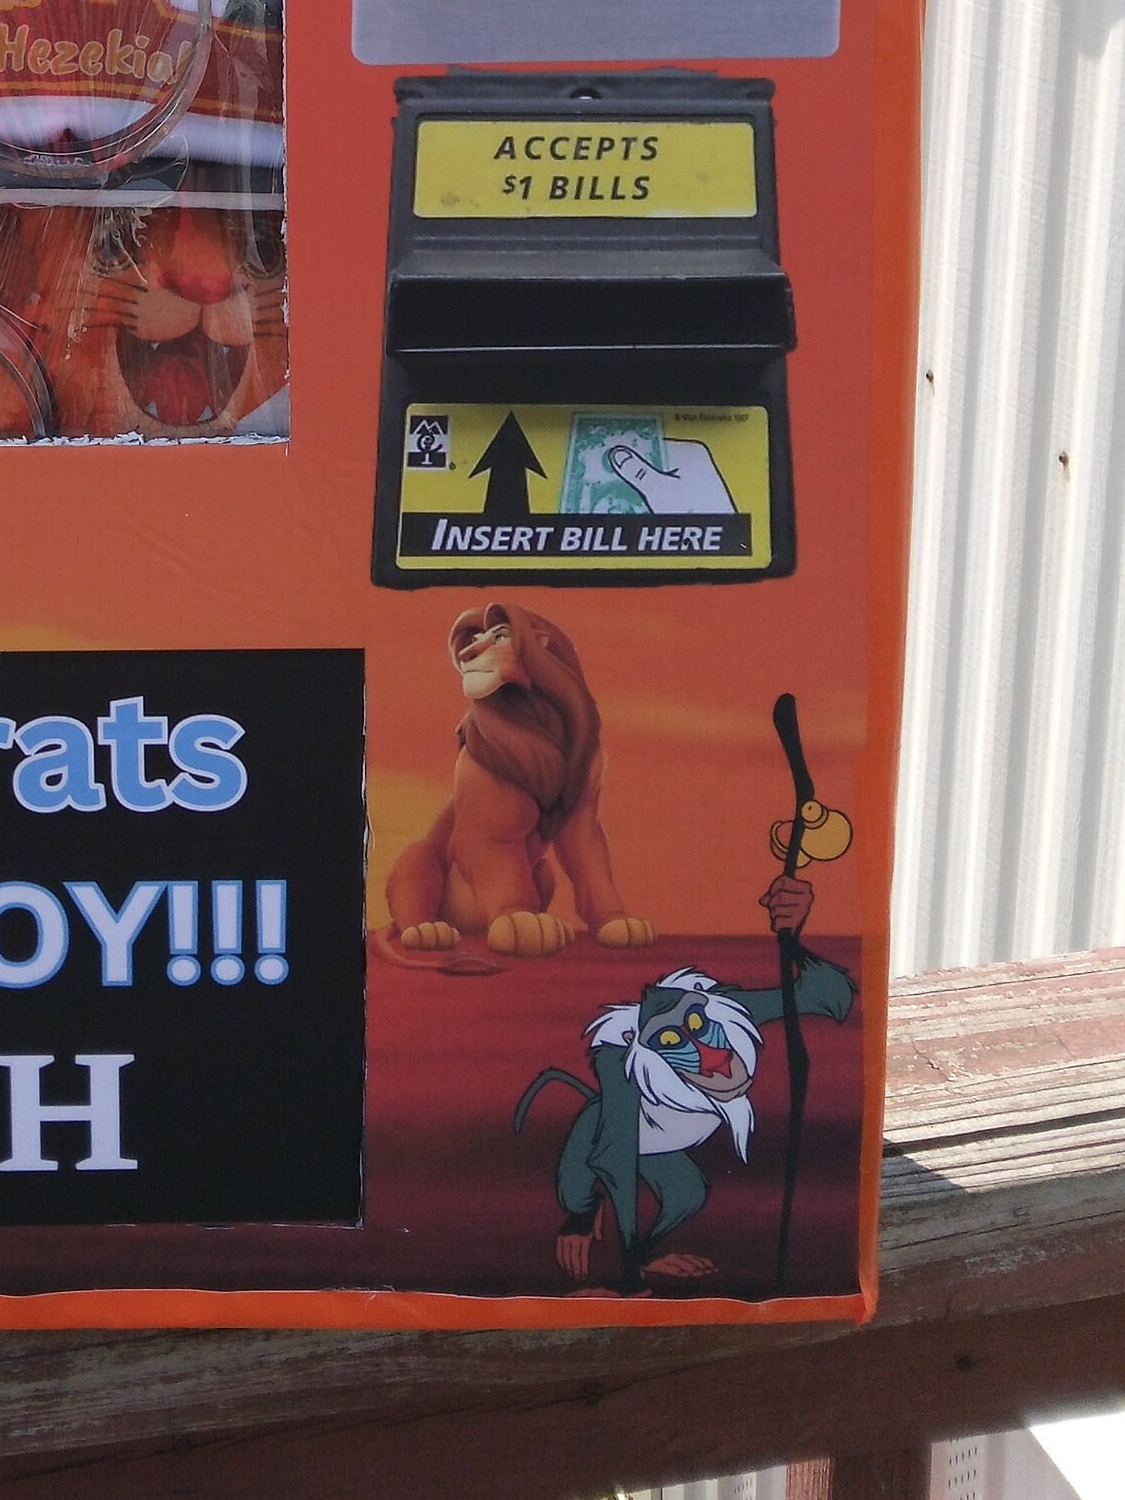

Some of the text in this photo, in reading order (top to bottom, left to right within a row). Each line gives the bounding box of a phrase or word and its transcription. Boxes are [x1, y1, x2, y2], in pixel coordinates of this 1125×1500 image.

[494, 135, 659, 161] ACCEPTS
[502, 174, 650, 200] $1 BILLS
[431, 518, 723, 551] INSERT BILL HERE
